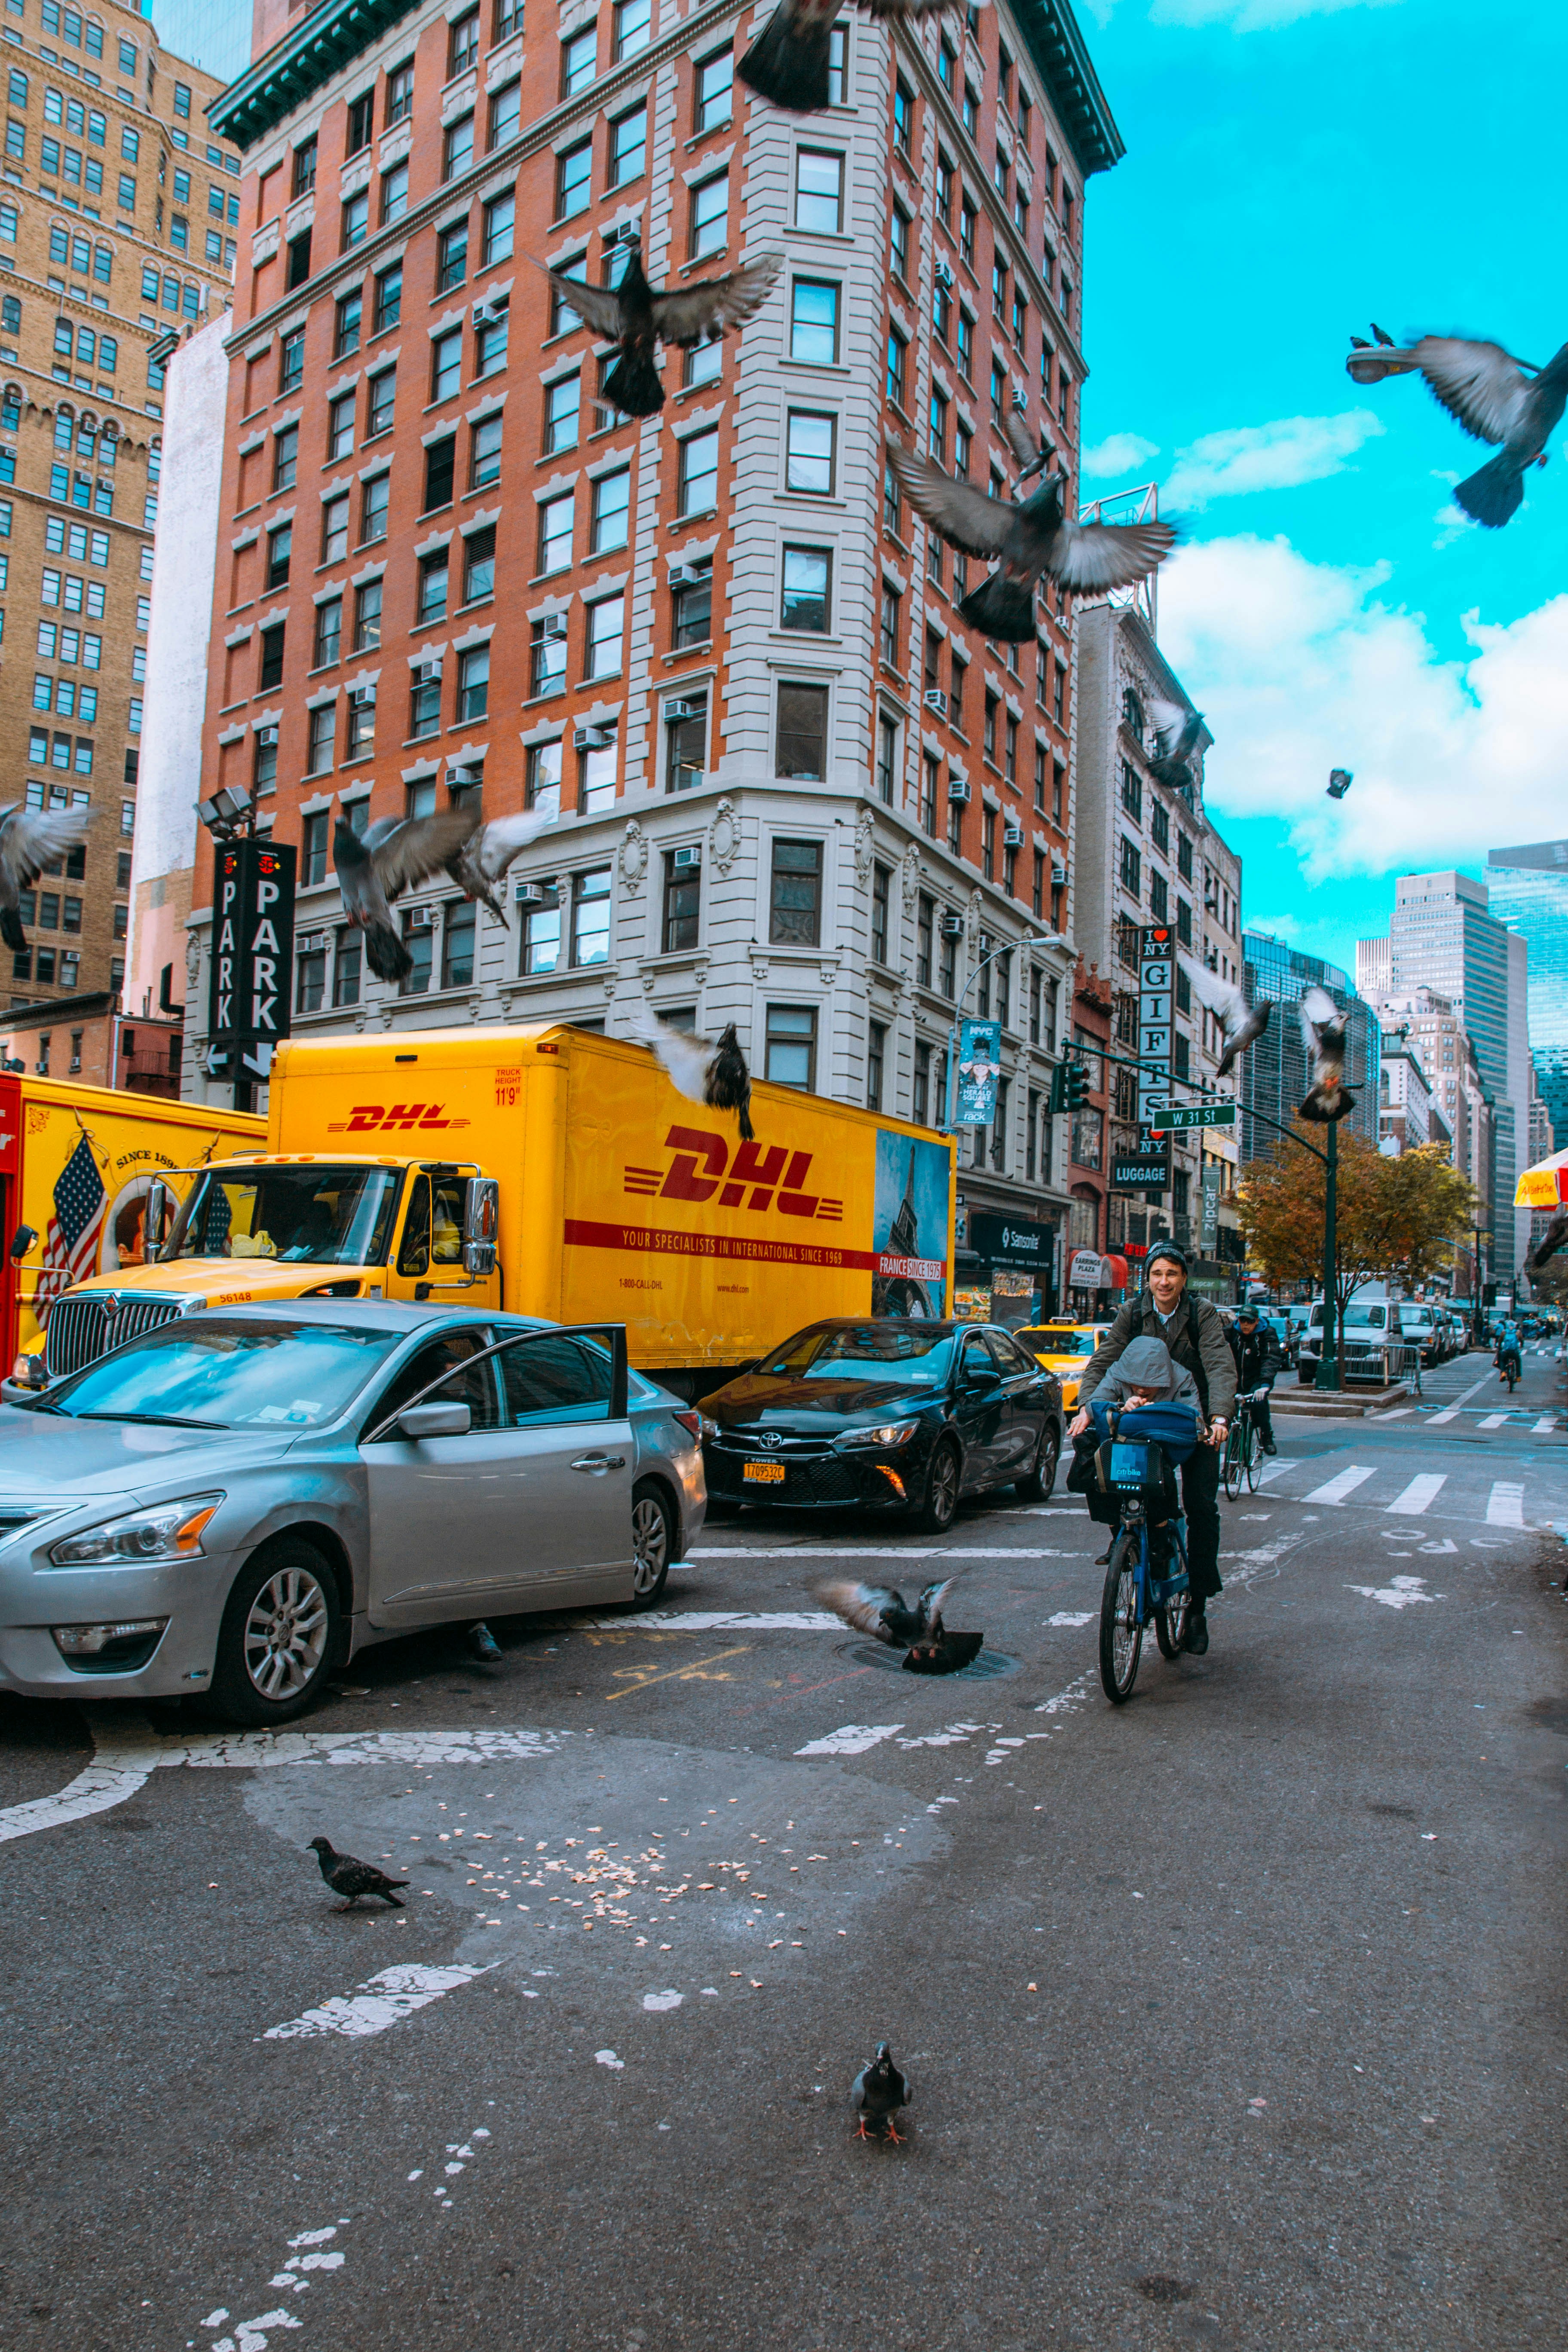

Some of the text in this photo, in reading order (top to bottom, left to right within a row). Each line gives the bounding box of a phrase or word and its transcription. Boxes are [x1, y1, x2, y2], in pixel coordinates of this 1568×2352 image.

[1146, 930, 1154, 942] I
[217, 881, 236, 1029] PARK
[251, 880, 280, 1030] PARK
[1143, 943, 1170, 956] NY
[970, 1026, 993, 1036] NYC
[346, 1103, 451, 1131] DHL
[964, 1112, 985, 1121] rack
[1173, 1110, 1215, 1125] W 31 St
[1142, 1127, 1150, 1139] I
[1139, 1141, 1167, 1153] NY
[116, 1150, 151, 1169] SINCE
[659, 1124, 820, 1217] DHL
[1117, 1167, 1165, 1181] LUGGAGE
[1202, 1185, 1217, 1231] zipcar
[1011, 1231, 1040, 1250] Samsonite
[623, 1230, 842, 1265] YOUR SPECIALISTS IN INTERNATIONAL SINCE 1969
[880, 1257, 940, 1278] FRANCE SINCE 1975
[1075, 1257, 1101, 1266] EARRINGS
[619, 1278, 662, 1289] 1-800-CALL-DHL
[717, 1283, 749, 1293] www.dhl.com
[220, 1292, 251, 1303] 56148
[747, 1465, 782, 1478] T709532C
